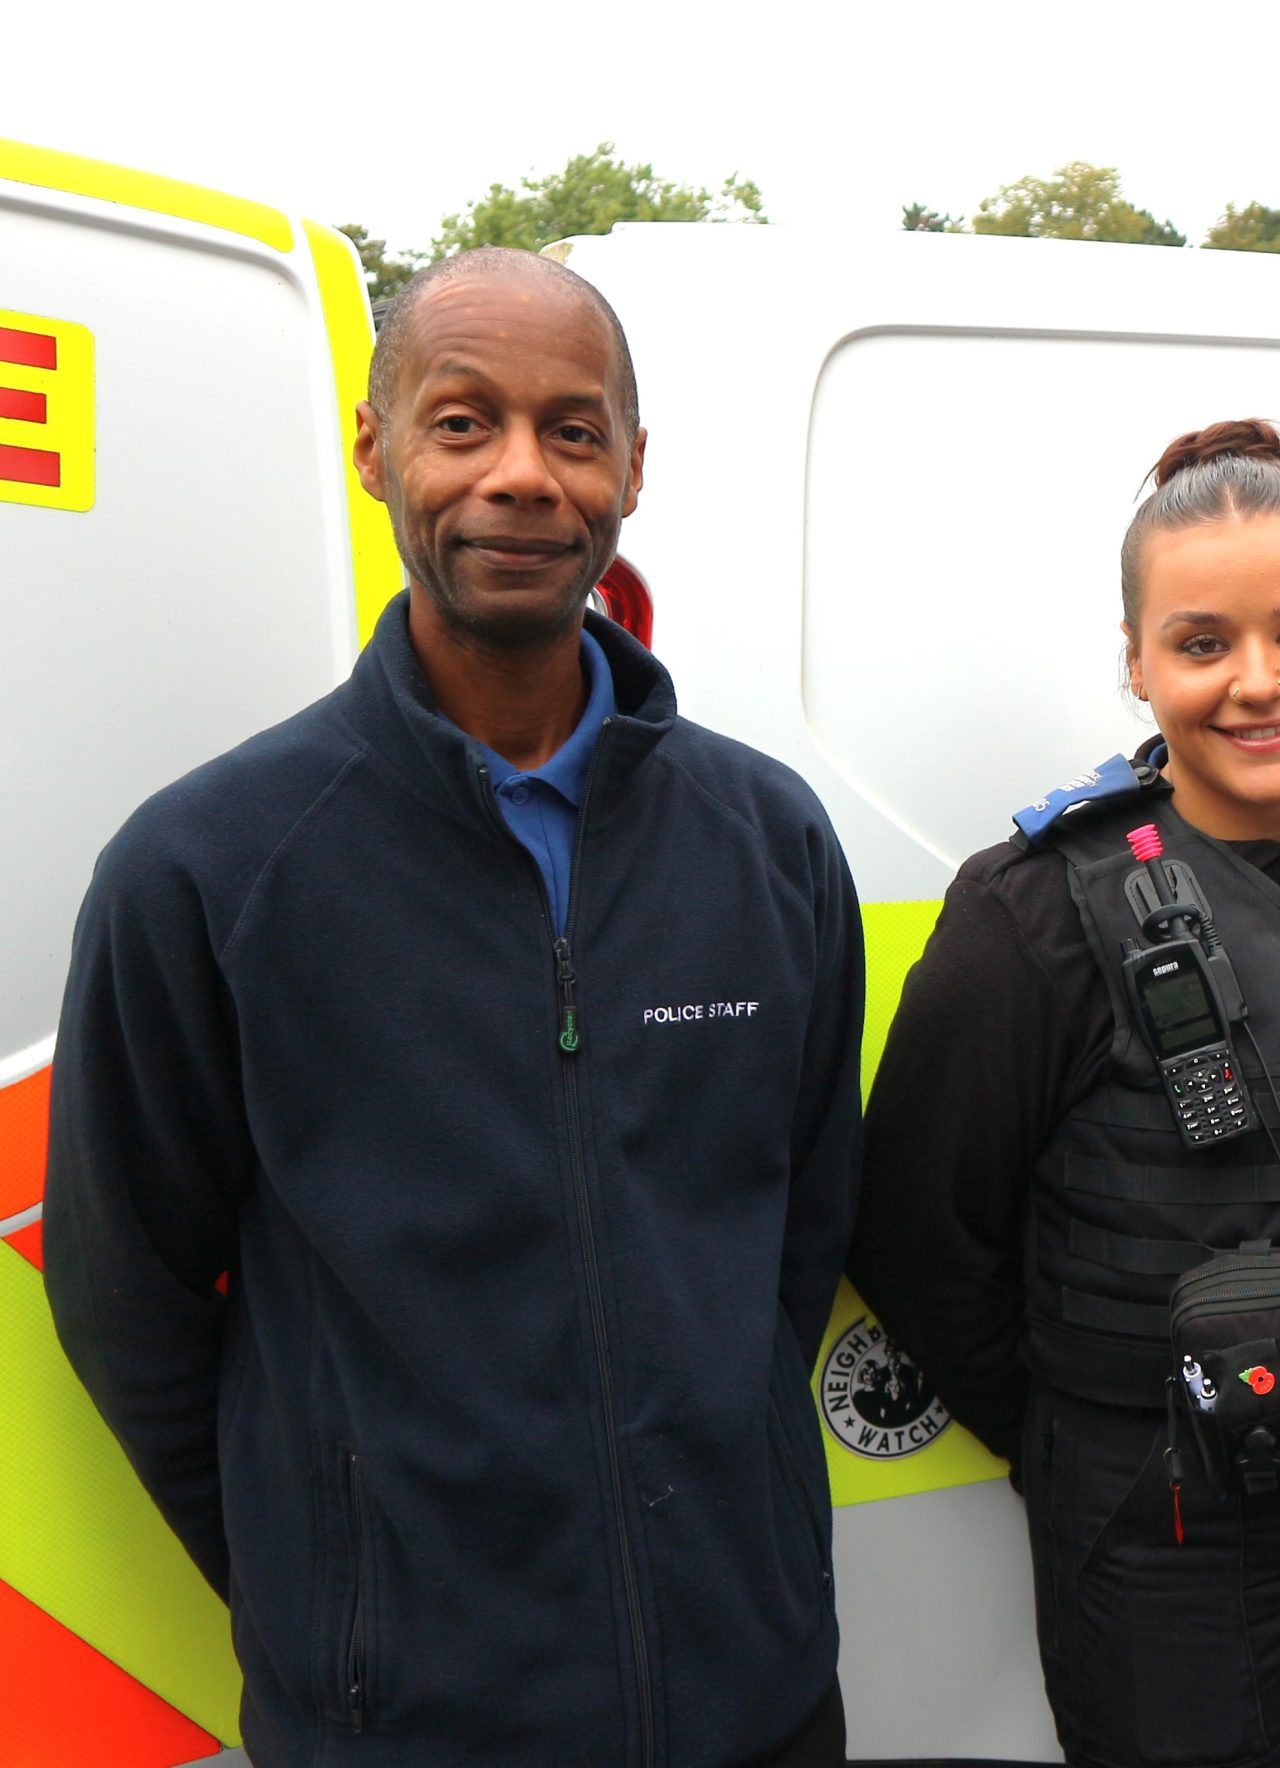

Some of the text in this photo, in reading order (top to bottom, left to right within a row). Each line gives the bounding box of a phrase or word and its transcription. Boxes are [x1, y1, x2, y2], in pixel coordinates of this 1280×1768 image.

[643, 1001, 760, 1025] POLICE STAFF
[828, 1325, 885, 1413] NEIGHB
[858, 1414, 939, 1452] WATCH
